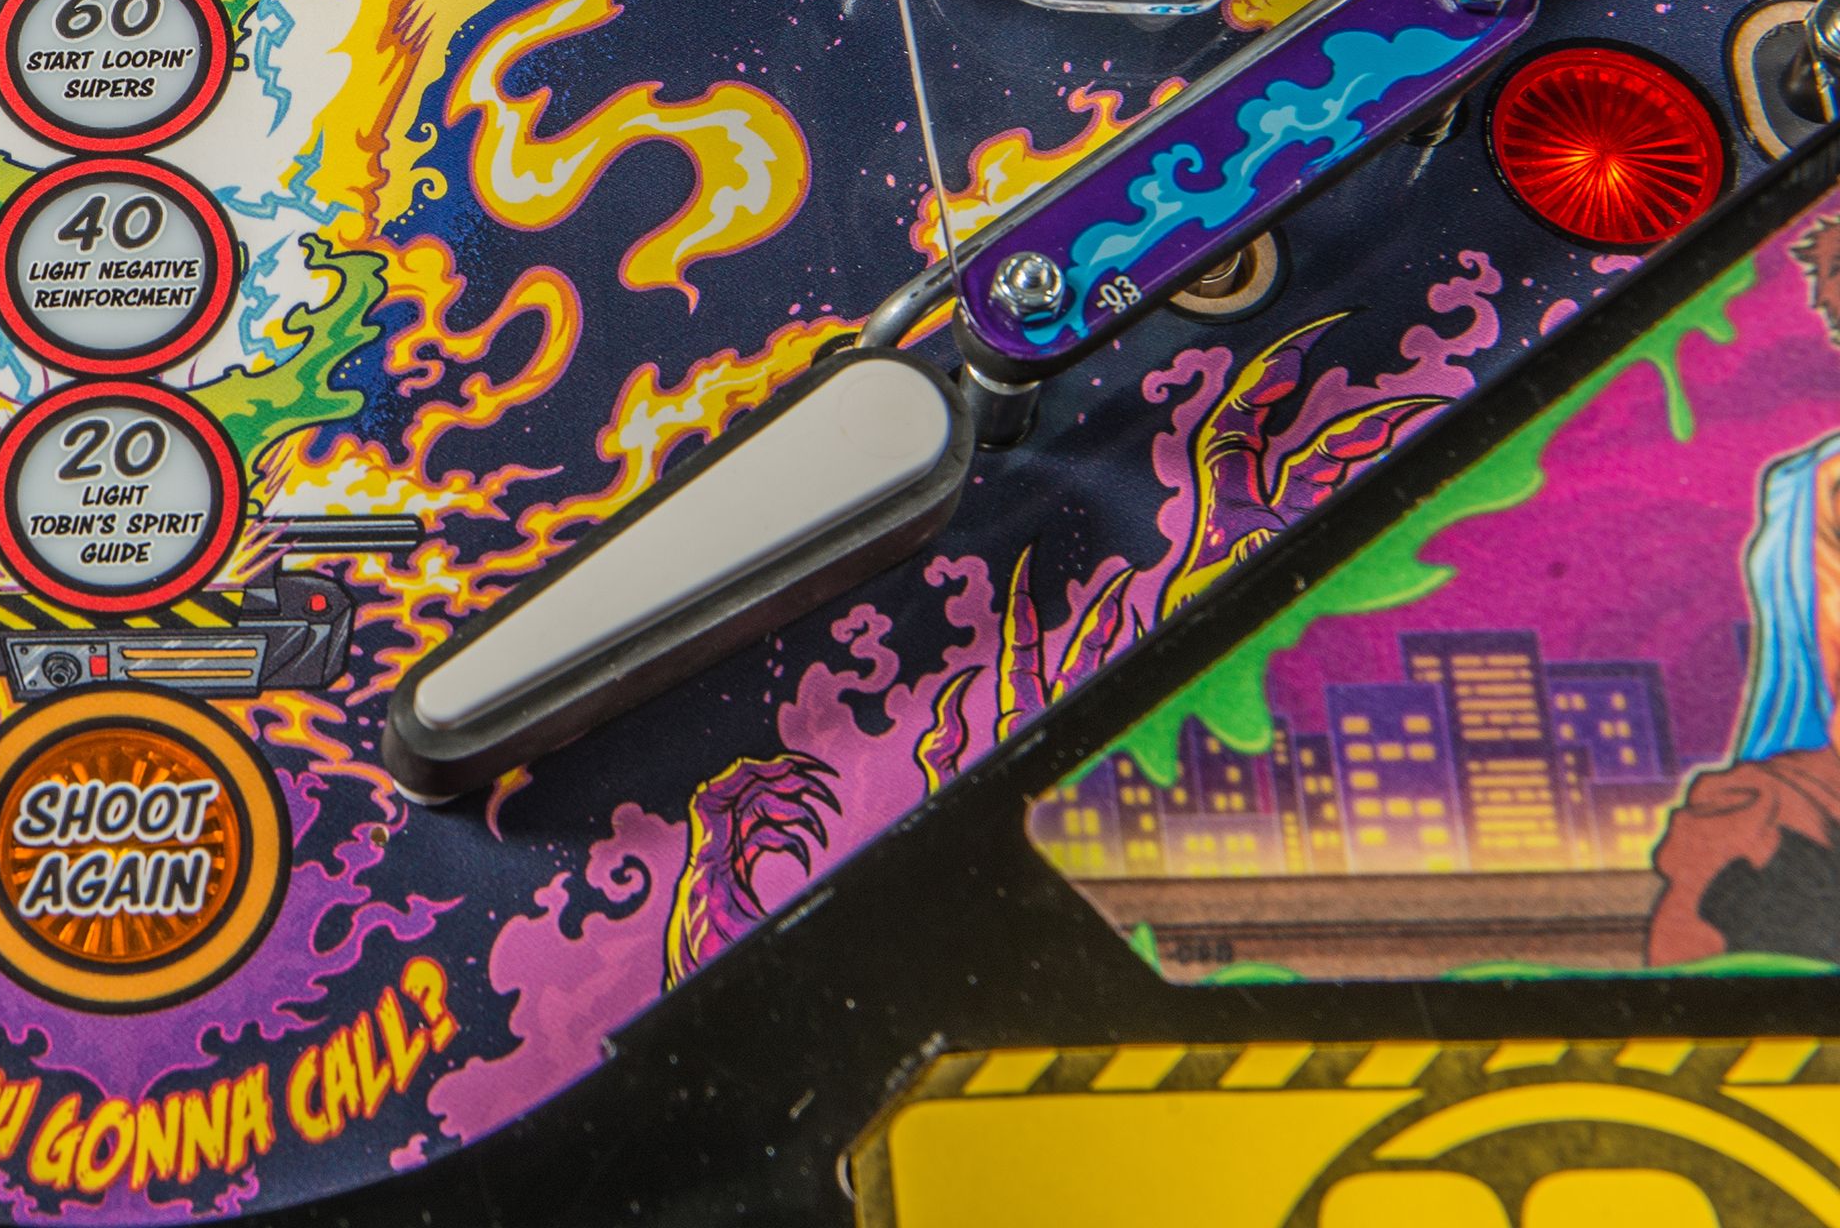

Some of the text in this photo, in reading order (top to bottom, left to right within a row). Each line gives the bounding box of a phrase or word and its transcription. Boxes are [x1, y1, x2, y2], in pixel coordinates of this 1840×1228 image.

[25, 48, 195, 71] START LOOPIN'
[63, 77, 156, 99] SUPERS
[56, 194, 165, 252] 40
[28, 259, 199, 281] LIGHT NEGATIVE
[34, 287, 197, 309] REINFORCMENT
[57, 417, 169, 482] 20
[81, 484, 148, 507] LIGHT
[29, 510, 205, 537] TOBIN'S SPIRIT
[80, 542, 152, 566] GUIDE
[16, 781, 219, 845] SHOOT
[20, 851, 210, 918] AGAIN
[28, 1065, 275, 1194] GONNA
[287, 956, 460, 1143] CALL?
